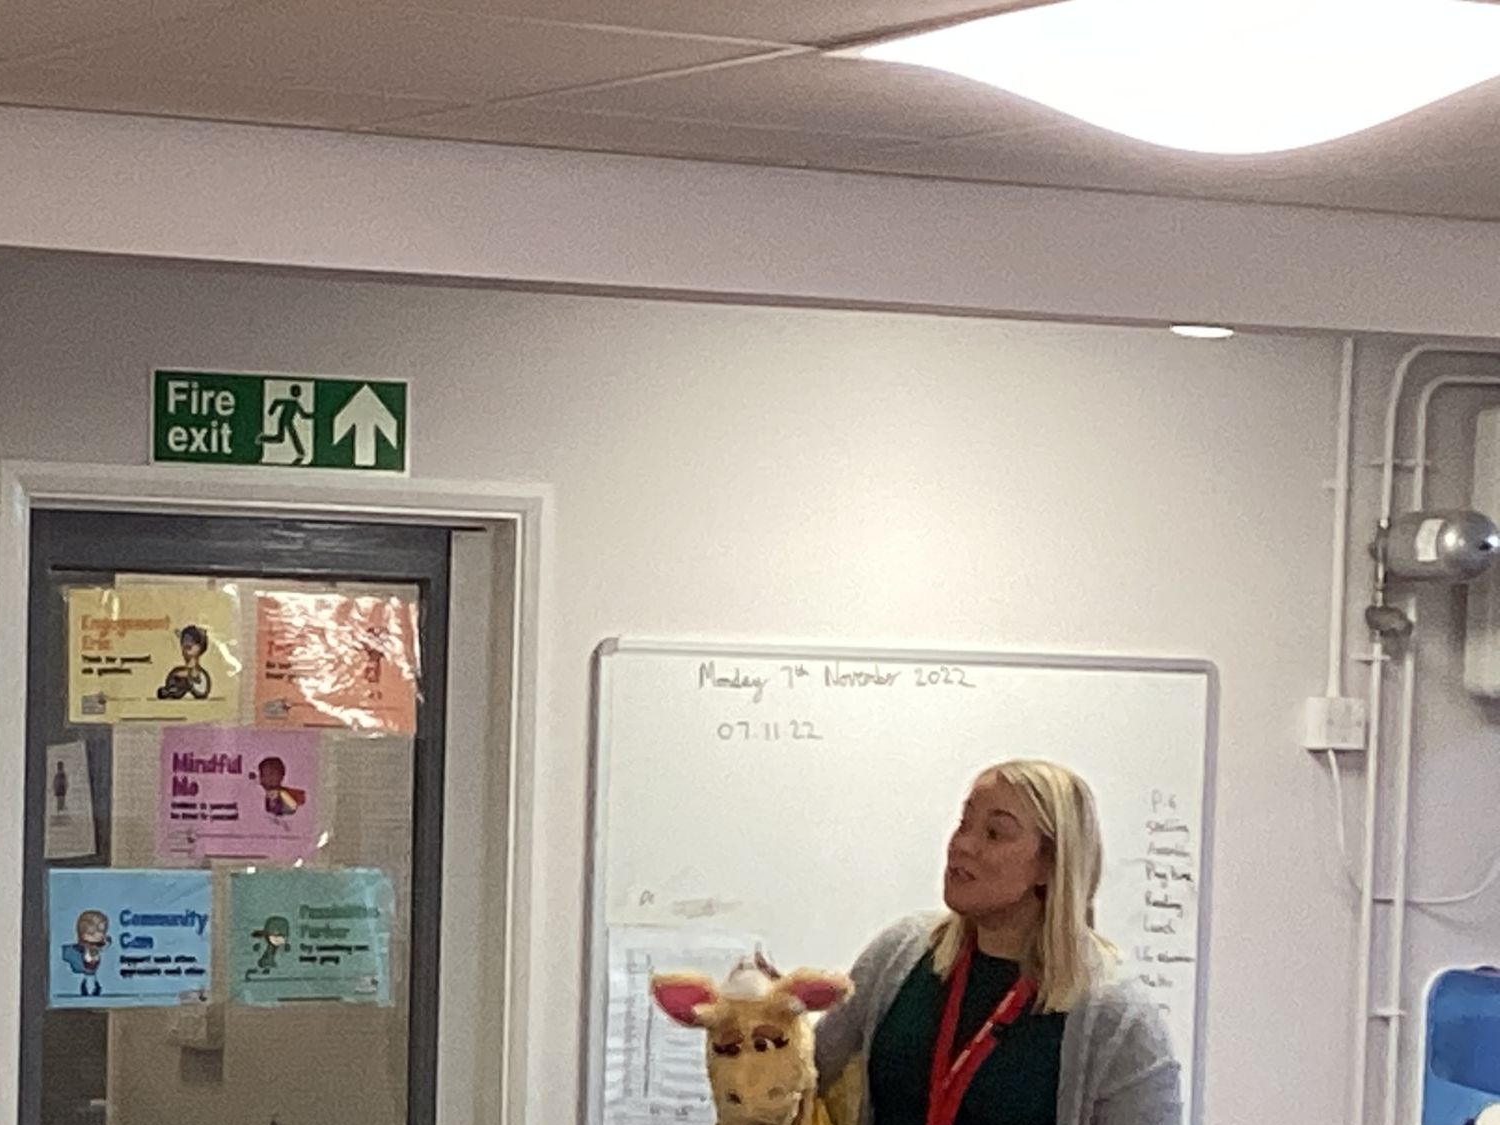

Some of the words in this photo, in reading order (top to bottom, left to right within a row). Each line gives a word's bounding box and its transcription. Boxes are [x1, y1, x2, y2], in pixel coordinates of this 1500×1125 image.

[168, 380, 236, 417] Fire
[167, 421, 233, 454] exit
[699, 661, 770, 703] Monday
[780, 664, 809, 688] 7th
[825, 661, 902, 688] November
[914, 665, 977, 688] 2022
[173, 751, 242, 774] Mindful
[120, 909, 208, 936] Community
